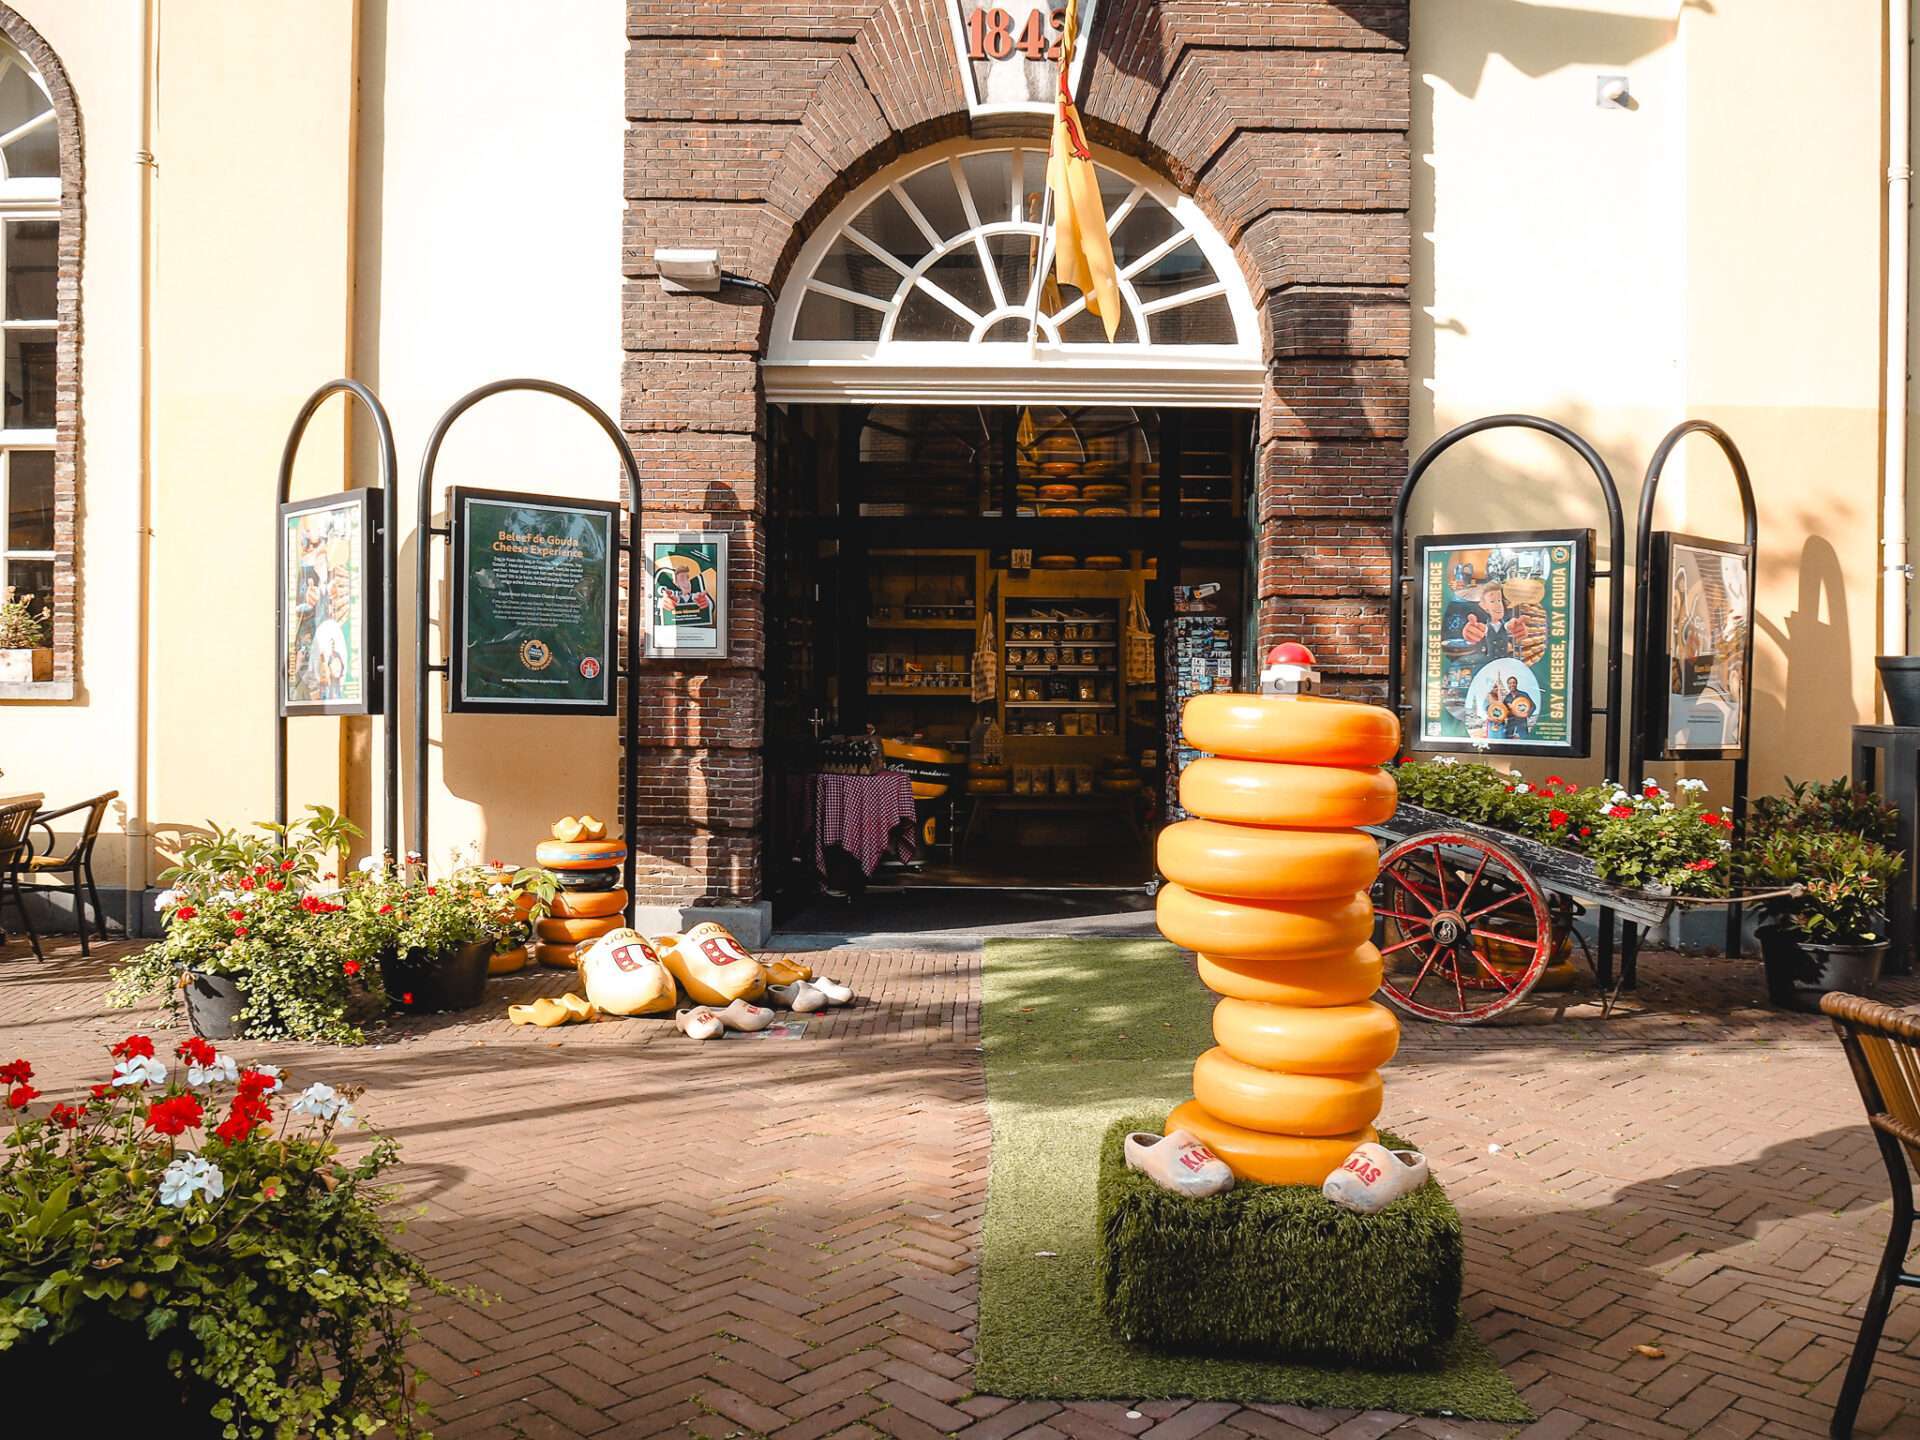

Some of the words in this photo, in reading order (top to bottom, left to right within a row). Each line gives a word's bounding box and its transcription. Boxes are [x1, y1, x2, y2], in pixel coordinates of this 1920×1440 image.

[492, 541, 529, 554] Cheese
[530, 544, 584, 558] Experience
[498, 530, 531, 543] Beleef
[533, 533, 545, 545] de
[547, 535, 579, 547] Gouda
[1428, 562, 1443, 631] EXPERIENCE
[1551, 567, 1567, 608] GOUDA
[1551, 611, 1566, 637] SAY
[1427, 634, 1442, 677] CHEESE
[1550, 639, 1566, 690] CHEESE,
[1427, 681, 1441, 719] GOUDA
[1550, 693, 1565, 719] SAY
[1179, 1147, 1217, 1170] KAA
[1340, 1158, 1382, 1183] AAS
